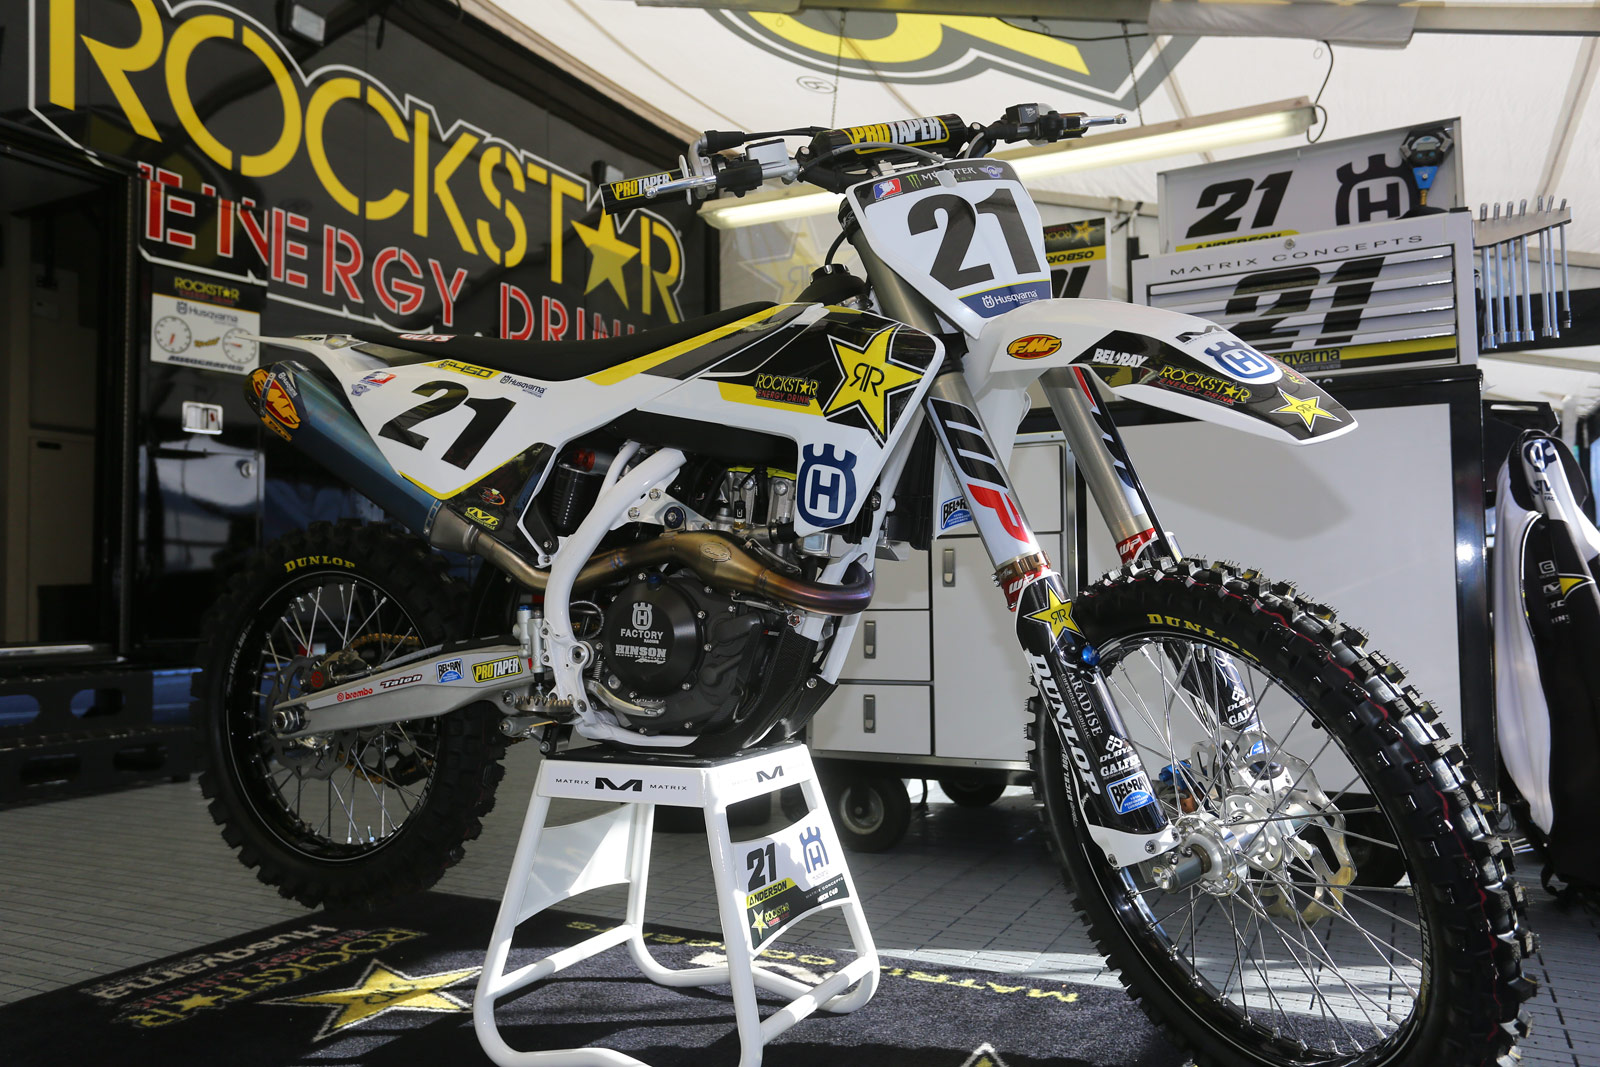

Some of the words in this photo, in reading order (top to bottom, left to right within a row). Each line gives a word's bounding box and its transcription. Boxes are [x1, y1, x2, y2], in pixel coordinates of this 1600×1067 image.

[1185, 170, 1293, 239] 21
[139, 162, 468, 327] ENERGY
[907, 188, 1042, 291] 21
[1170, 257, 1258, 276] MATRIX
[1272, 234, 1423, 262] CONCEPTS
[994, 289, 1038, 306] Husqvarna
[1223, 257, 1386, 349] 21
[1008, 338, 1062, 355] FMF
[508, 378, 546, 395] Husqvarna
[757, 388, 785, 401] ENERGY
[787, 393, 810, 405] DRINK
[1160, 378, 1200, 394] ENERGY
[1203, 390, 1236, 405] DRINK
[378, 380, 517, 471] 21
[284, 554, 356, 573] DUNLOP
[620, 628, 664, 640] FACTORY
[1146, 613, 1261, 663] DUNLOP
[615, 644, 667, 658] HINSON
[345, 687, 374, 700] brembo
[1064, 670, 1104, 737] ARADISE
[1030, 653, 1101, 796] DUNLOP
[649, 783, 688, 791] MATRIX
[746, 842, 777, 893] 21
[749, 879, 788, 906] ANDERSON
